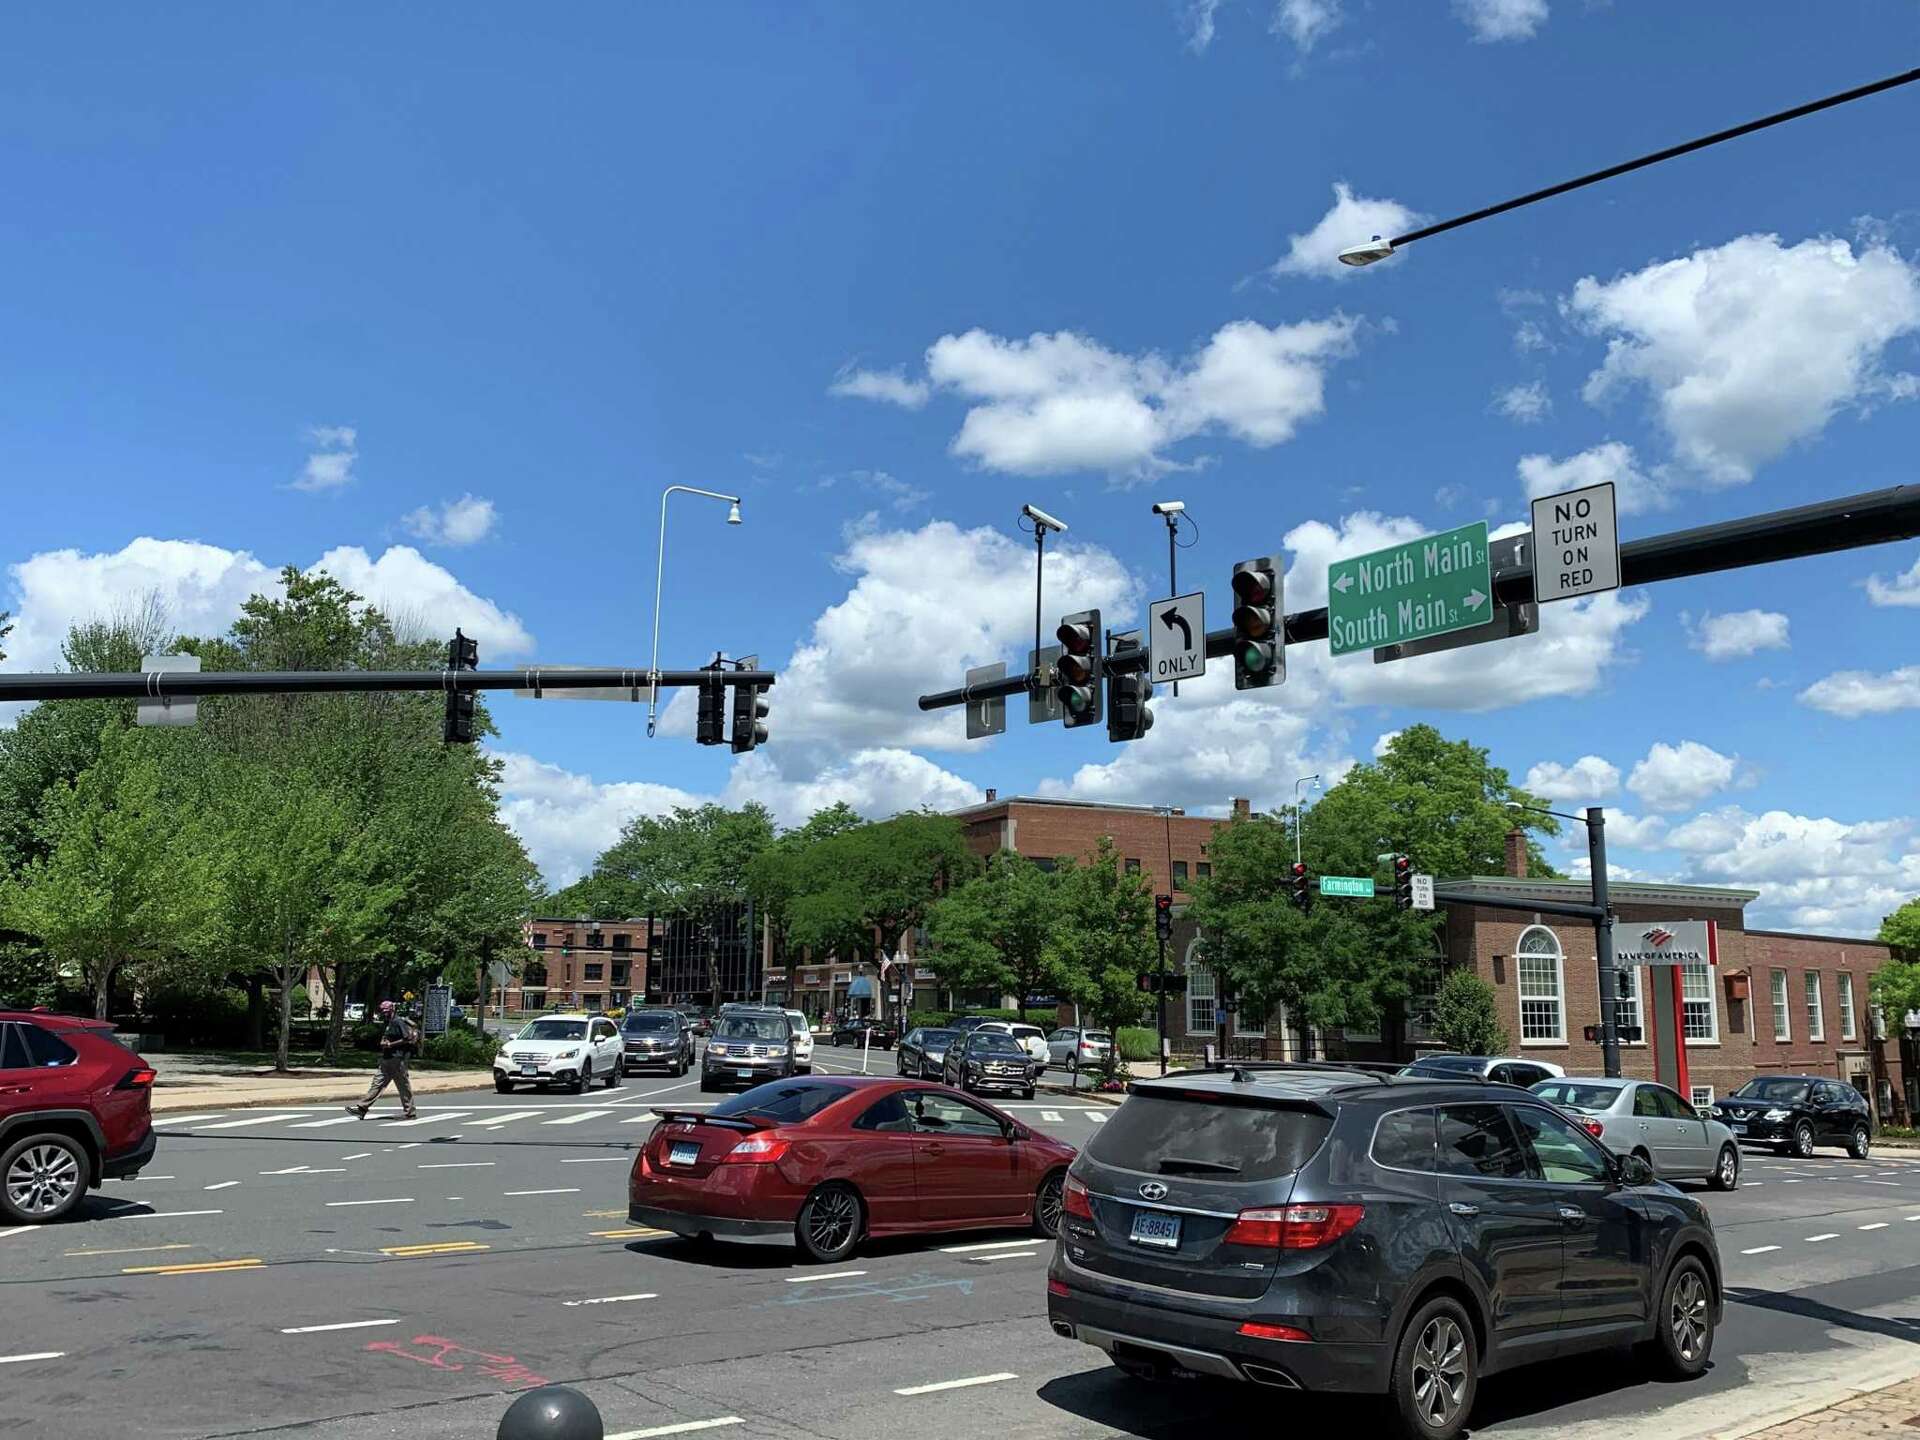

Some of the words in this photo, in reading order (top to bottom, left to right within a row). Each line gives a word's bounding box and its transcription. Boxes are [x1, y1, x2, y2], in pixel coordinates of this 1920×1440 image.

[1555, 498, 1590, 523] NO
[1552, 522, 1597, 546] TURN
[1358, 550, 1414, 595] North
[1423, 535, 1473, 578] Main
[1476, 548, 1485, 565] St
[1563, 546, 1588, 566] ON
[1560, 568, 1593, 589] RED
[1332, 605, 1388, 649] South
[1398, 593, 1446, 635] Main
[1449, 608, 1459, 623] St
[1158, 654, 1198, 675] ONLY
[1416, 877, 1427, 885] NO
[1618, 952, 1642, 960] BANK
[1644, 952, 1655, 960] OF
[1657, 951, 1701, 960] AMERICA
